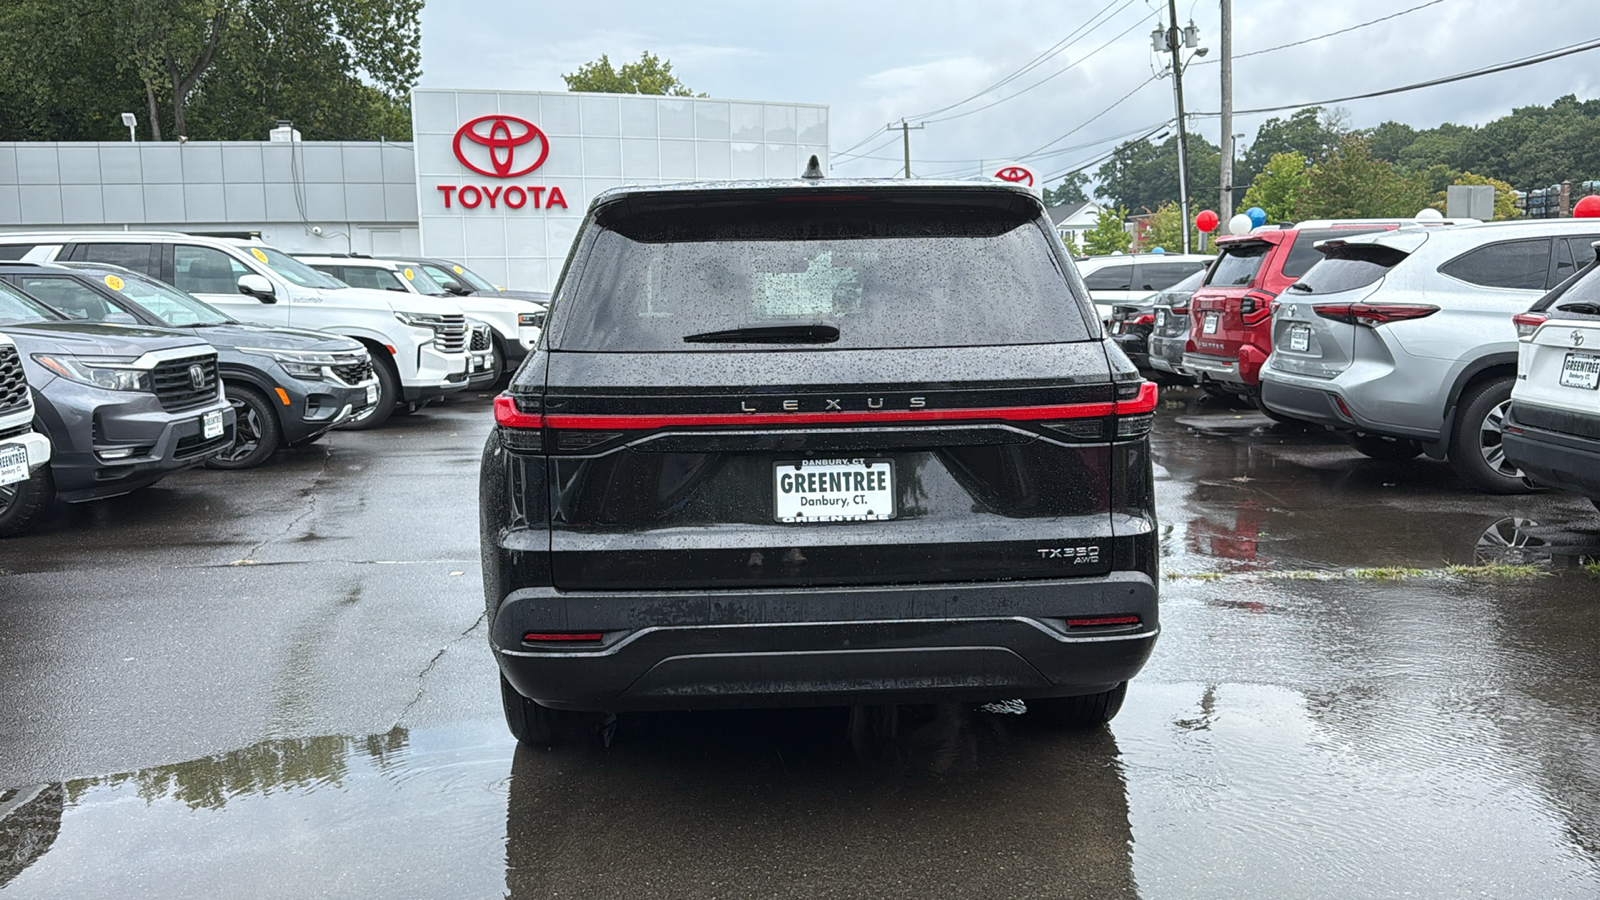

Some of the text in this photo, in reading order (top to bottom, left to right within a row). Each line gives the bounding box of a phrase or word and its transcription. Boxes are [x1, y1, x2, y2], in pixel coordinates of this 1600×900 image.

[437, 185, 568, 209] TOYOTA
[1565, 360, 1599, 373] GREENTREE
[741, 397, 926, 412] LEXUS
[0, 451, 26, 468] REENTREE
[780, 471, 887, 493] GREENTREE
[800, 494, 868, 508] Danbury, CT.
[1037, 546, 1100, 558] TX350
[1073, 556, 1099, 564] AWD
